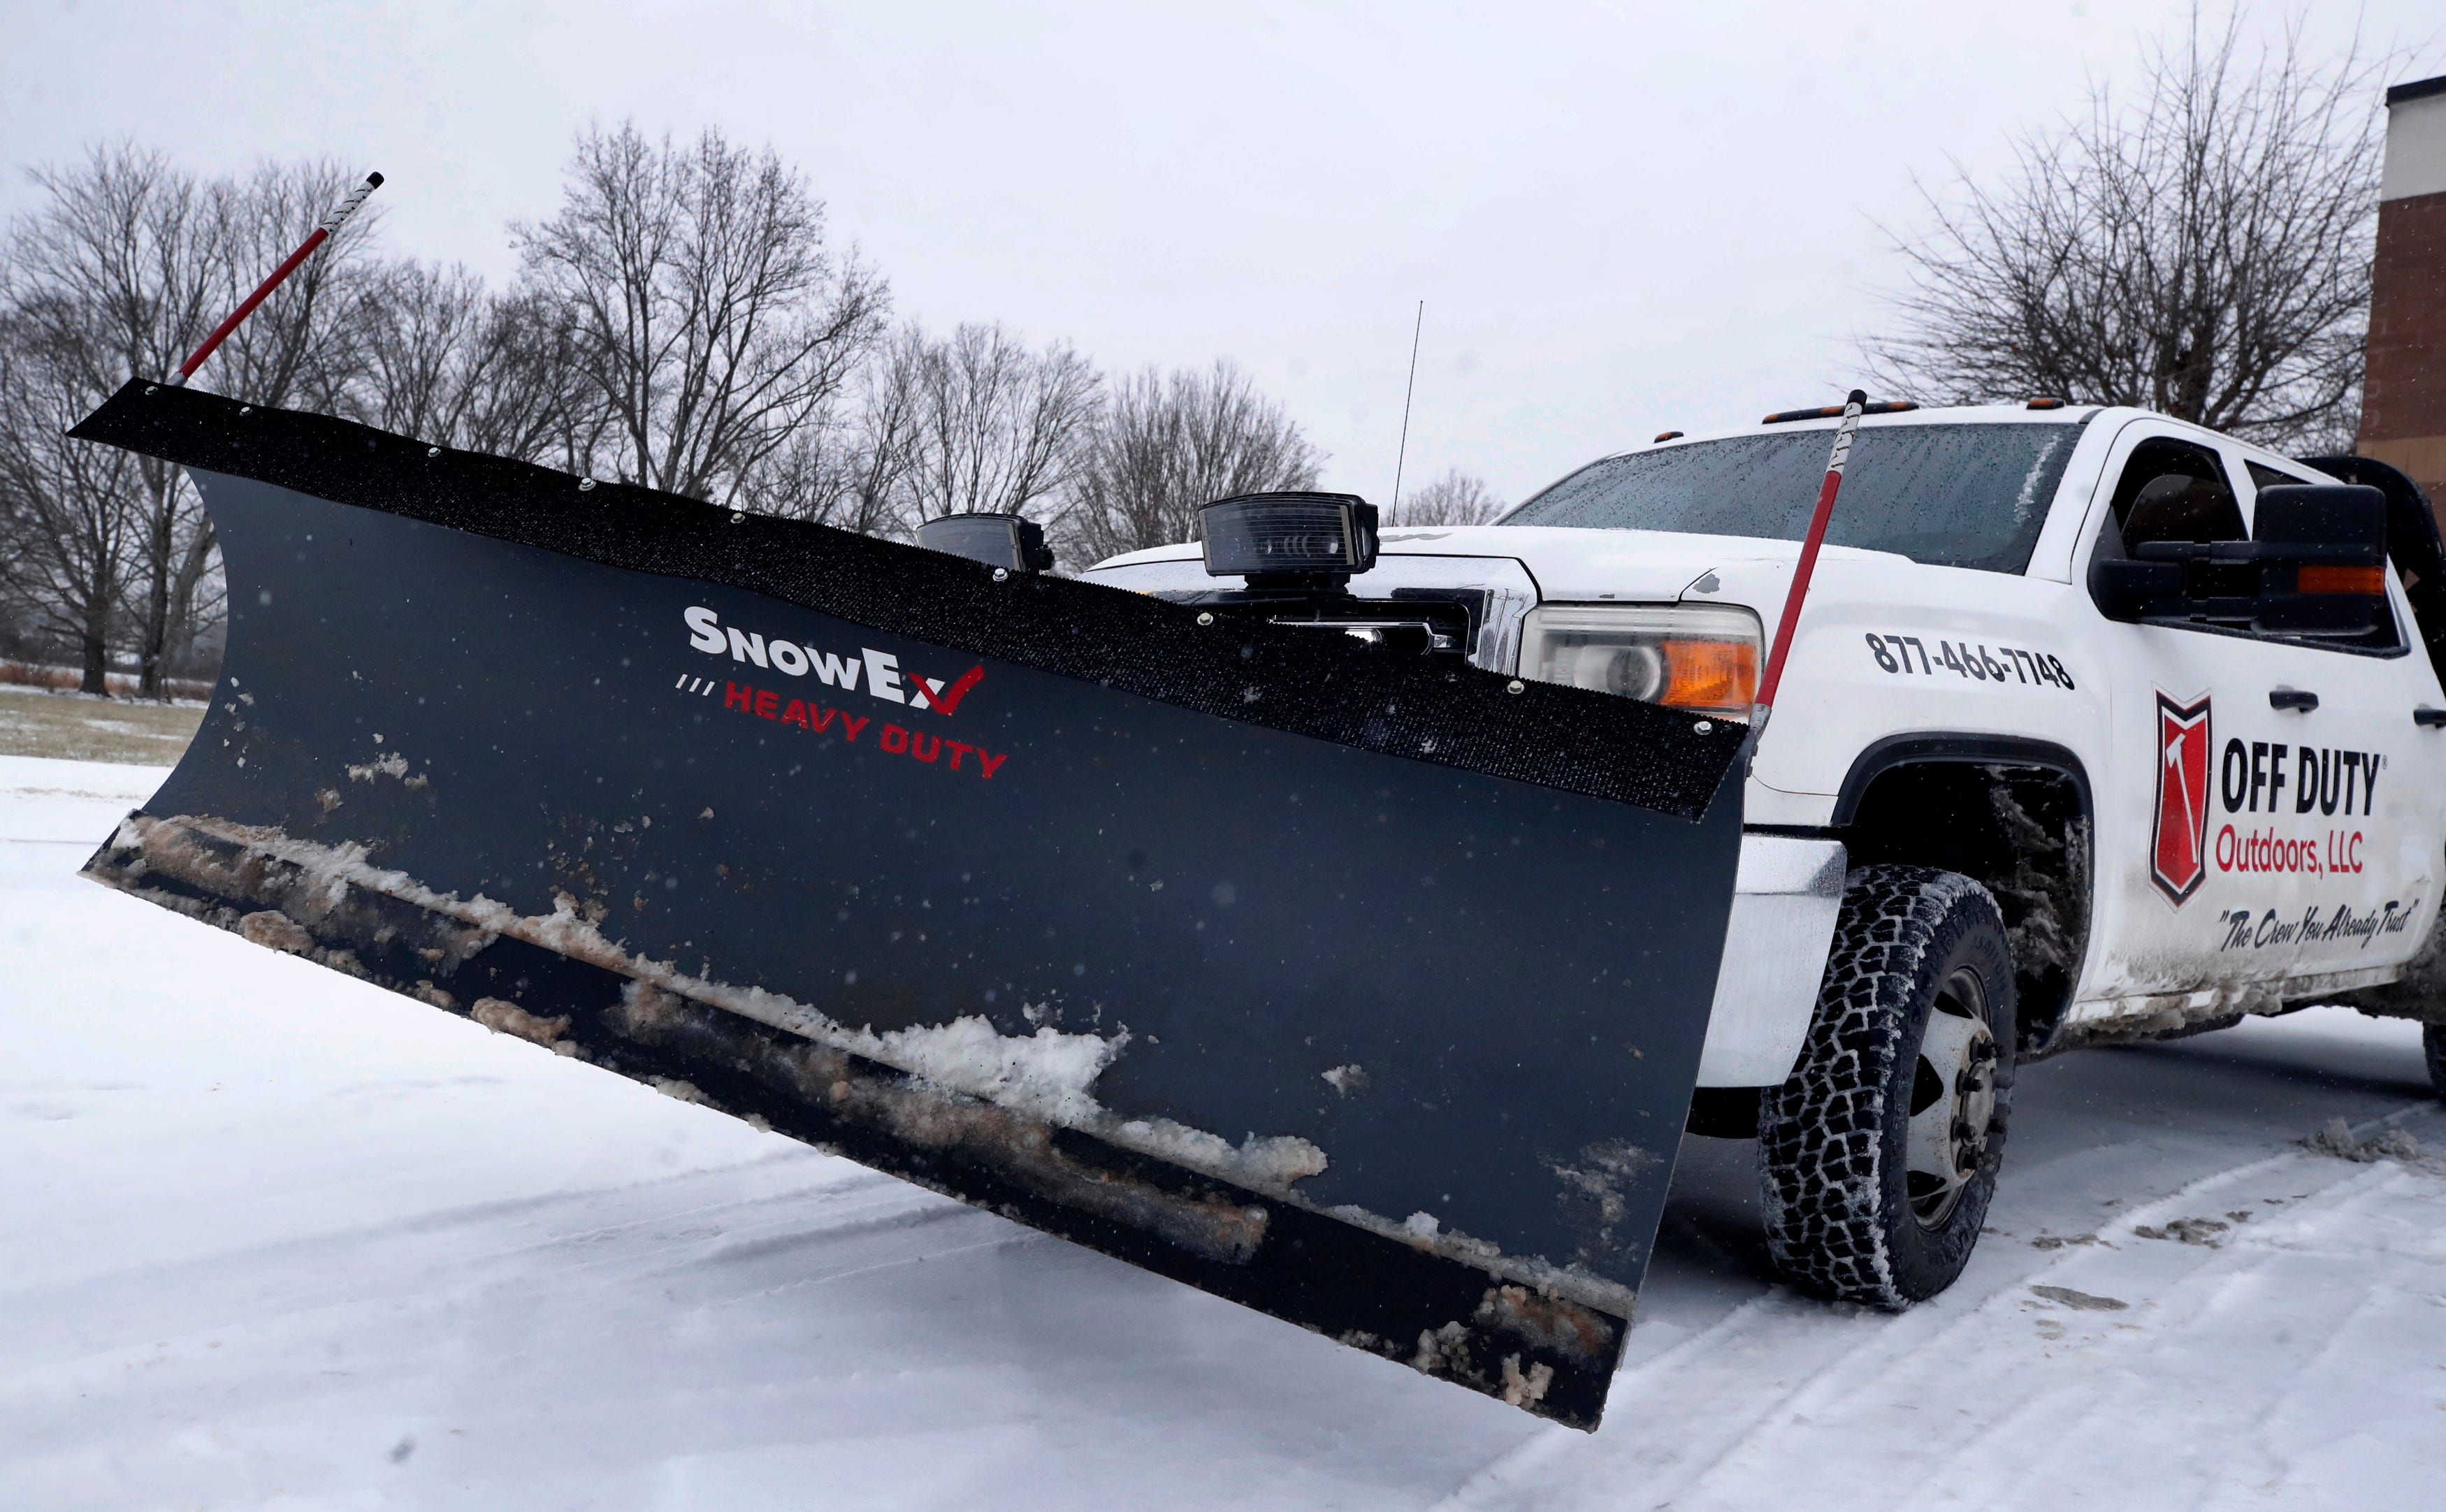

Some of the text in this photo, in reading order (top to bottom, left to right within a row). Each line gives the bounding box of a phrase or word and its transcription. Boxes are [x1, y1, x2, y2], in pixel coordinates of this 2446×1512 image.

[1865, 633, 2075, 690] 877-466-7748
[724, 681, 1008, 779] HEAVY DUTY
[2222, 737, 2288, 813] OFF
[2215, 824, 2364, 880] Outdoors, LLC
[2219, 899, 2419, 952] "The Crew You Already Trust"
